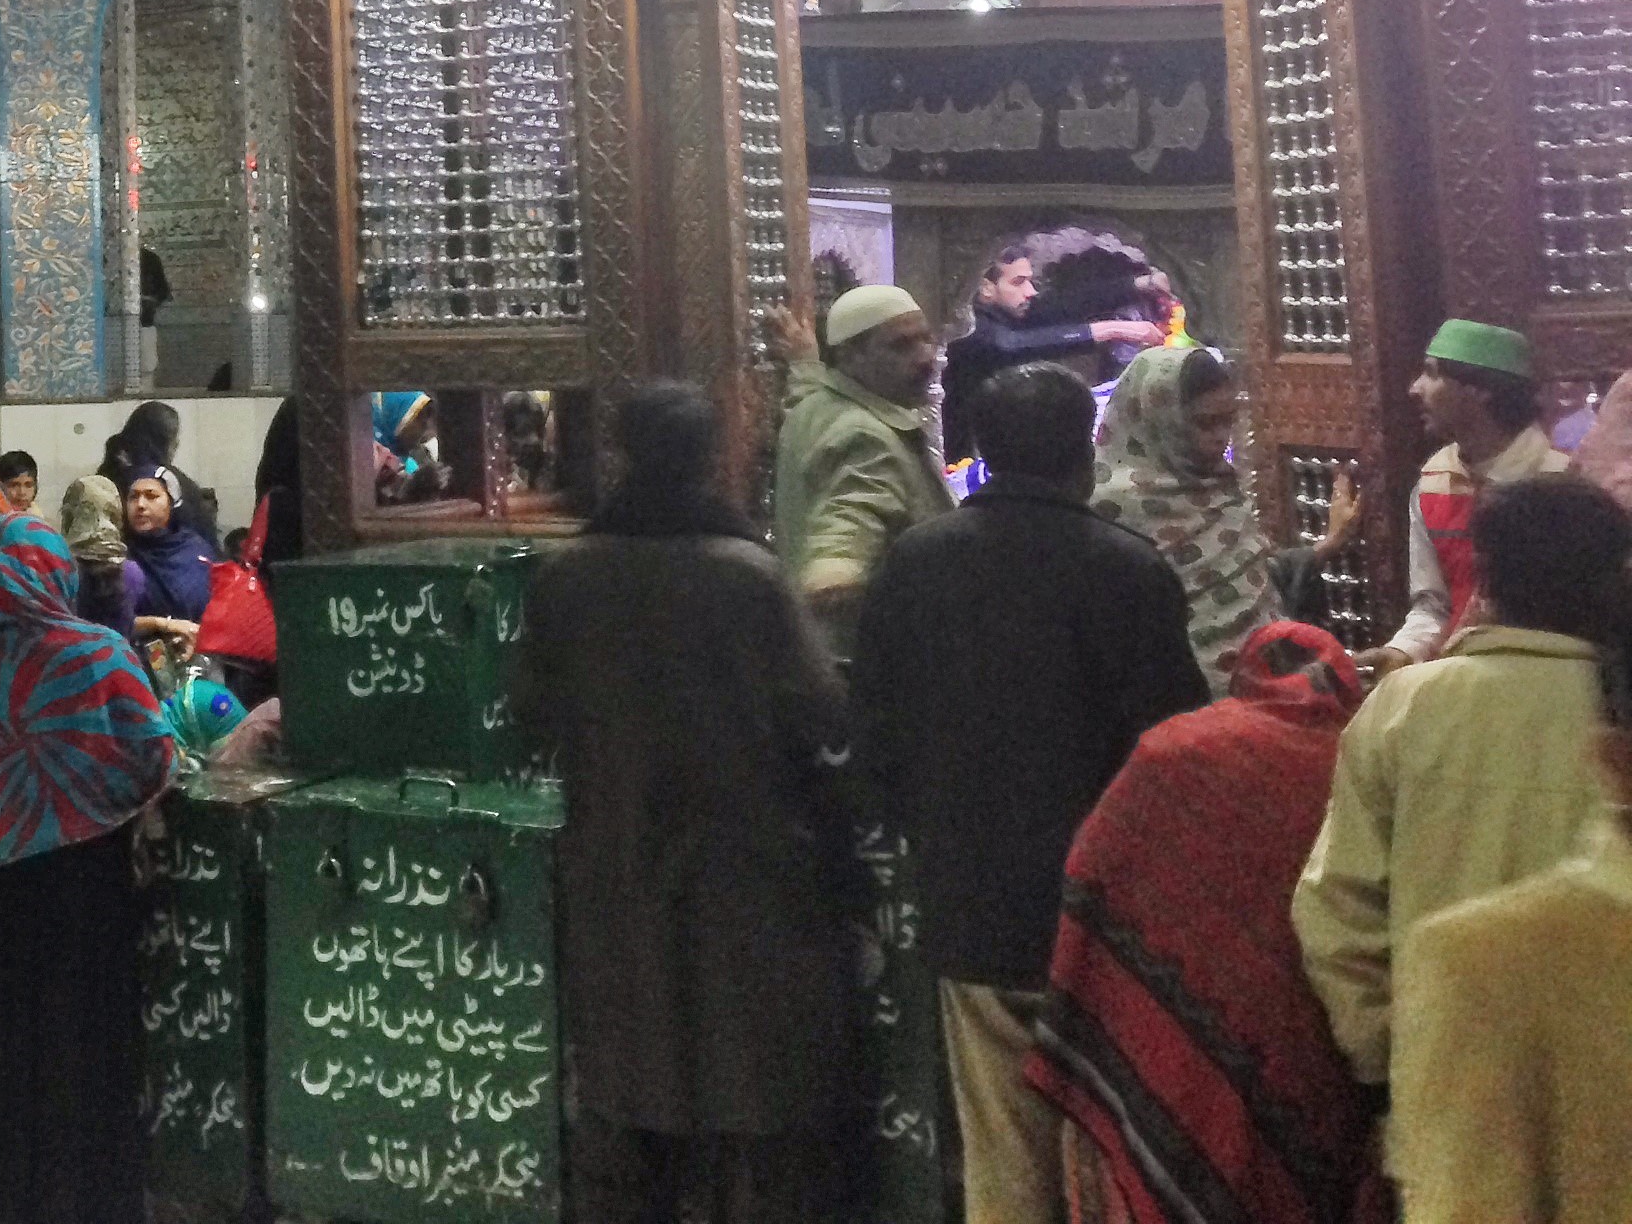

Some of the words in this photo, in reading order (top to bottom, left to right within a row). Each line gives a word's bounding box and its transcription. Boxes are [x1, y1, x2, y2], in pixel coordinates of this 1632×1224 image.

[358, 845, 450, 907] نذرانہ
[392, 927, 444, 992] اپنے
[454, 930, 479, 977] کا
[473, 938, 546, 998] دربار
[303, 981, 380, 1039] ڈالیں
[380, 1007, 435, 1045] میں
[512, 1019, 550, 1053] سے
[376, 1068, 422, 1109] میں
[487, 1072, 552, 1123] کسی
